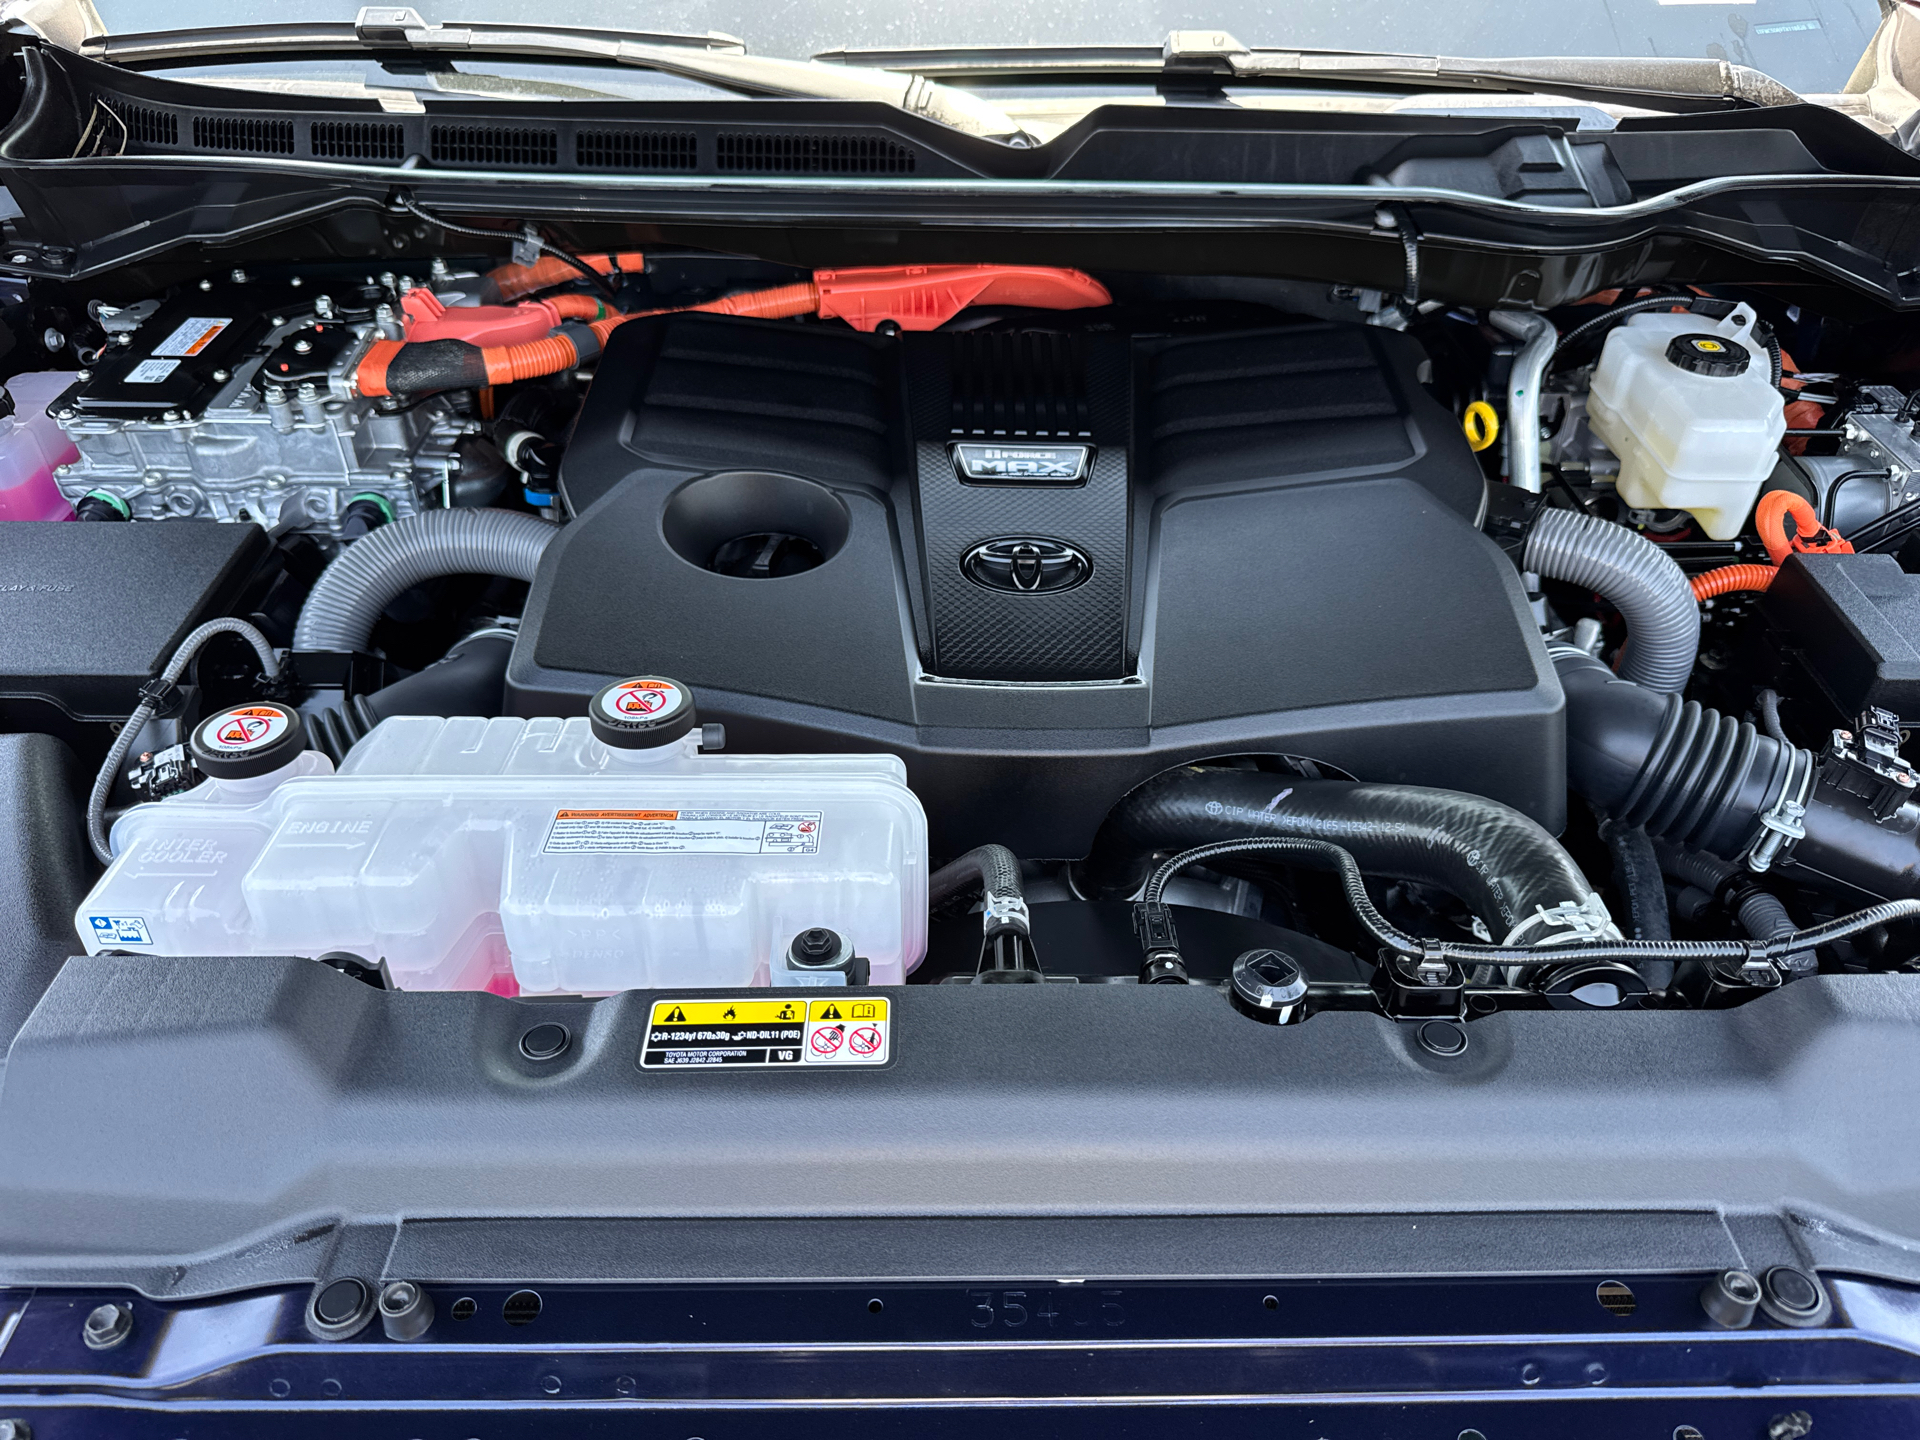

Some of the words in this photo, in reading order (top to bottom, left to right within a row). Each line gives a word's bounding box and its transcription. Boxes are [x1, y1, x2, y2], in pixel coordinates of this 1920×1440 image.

[971, 459, 1075, 473] MAX
[38, 584, 75, 592] FUSE
[1224, 805, 1244, 816] CIP
[1247, 809, 1277, 823] WATER
[1315, 819, 1339, 831] 2165
[285, 820, 373, 834] ENGINE
[145, 838, 218, 851] INTER
[138, 850, 228, 864] COOLER
[661, 1031, 696, 1042] R-1234yf
[697, 1031, 730, 1041] 670±30g
[780, 1030, 800, 1040] (POE)
[778, 1051, 794, 1060] VG
[969, 1290, 1126, 1328] 3545
